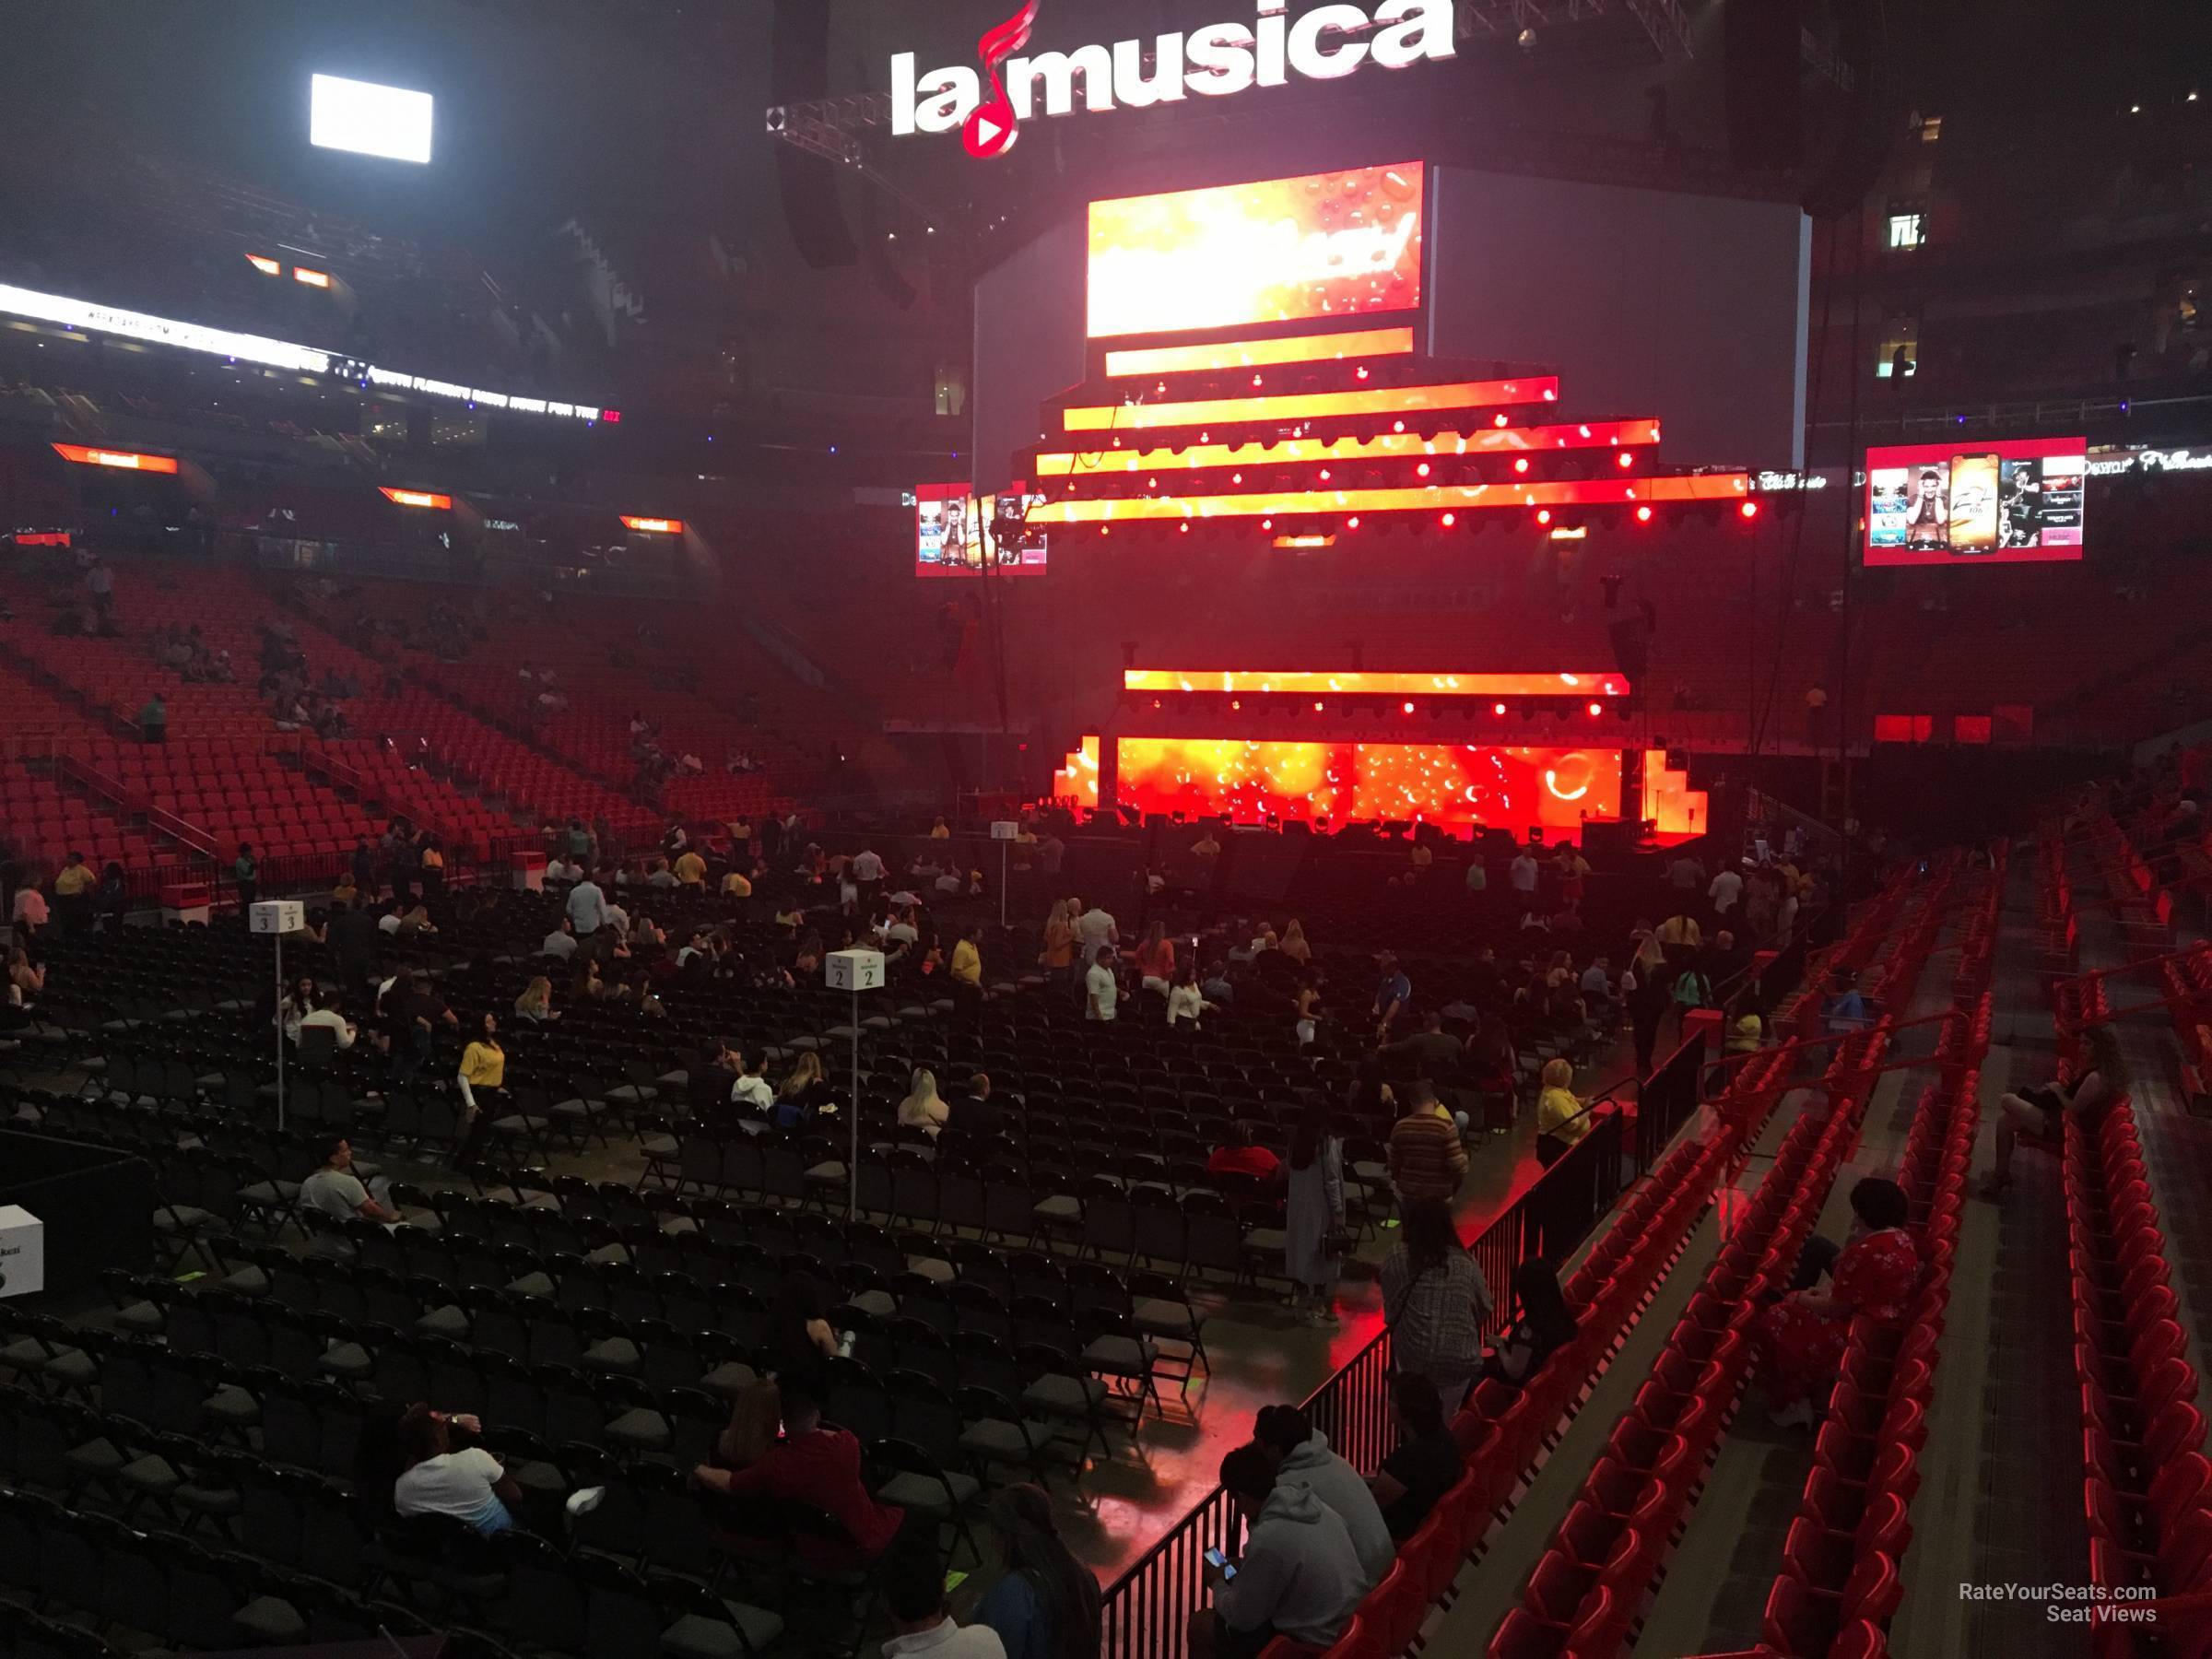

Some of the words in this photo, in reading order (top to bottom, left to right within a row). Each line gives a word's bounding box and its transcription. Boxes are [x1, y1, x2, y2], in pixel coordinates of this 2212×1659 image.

[1007, 0, 1456, 118] musica
[260, 917, 268, 931] 3
[288, 915, 295, 930] 3
[836, 970, 843, 986] 2
[865, 970, 873, 986] 2
